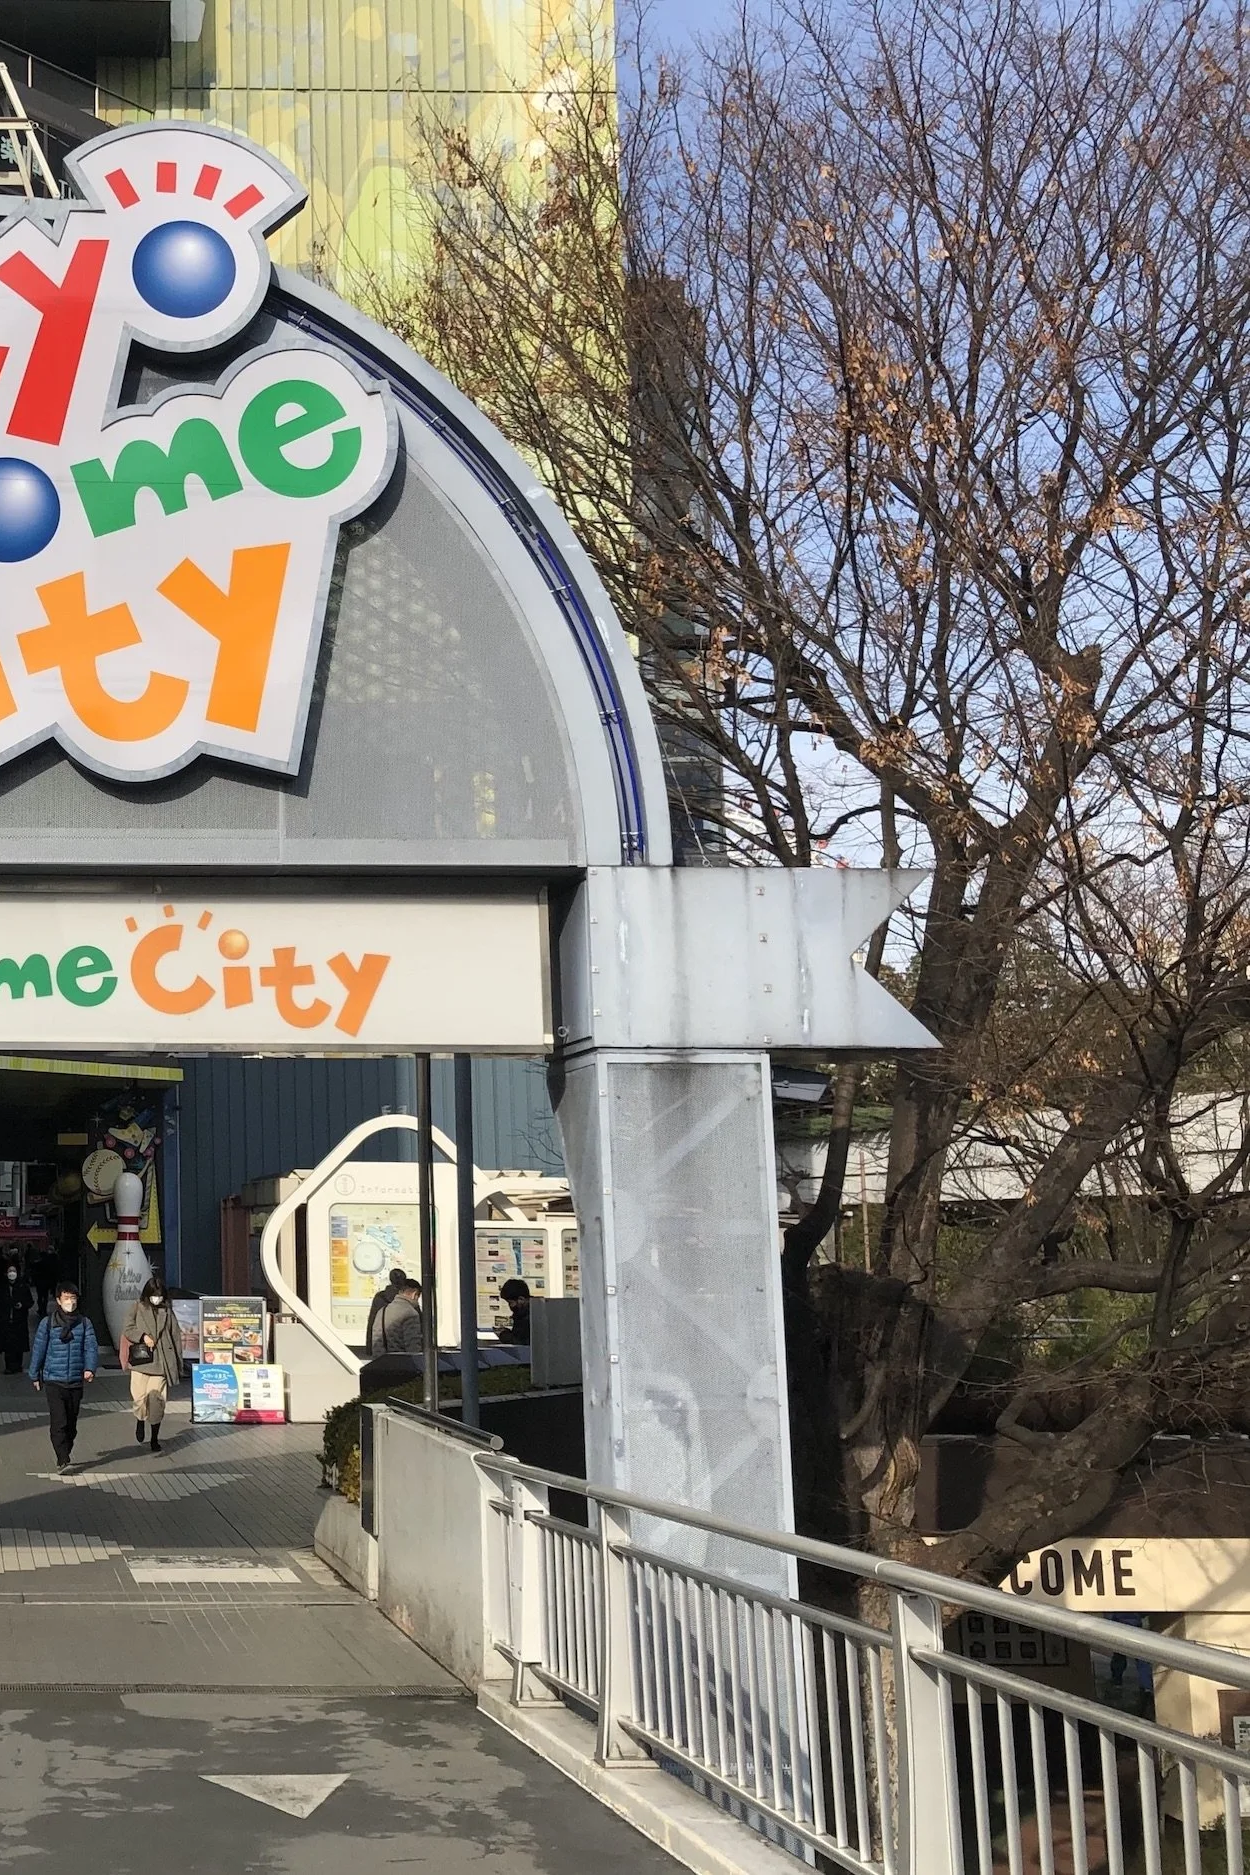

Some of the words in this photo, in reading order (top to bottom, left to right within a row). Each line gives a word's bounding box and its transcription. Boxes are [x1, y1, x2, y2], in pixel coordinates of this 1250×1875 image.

[129, 923, 392, 1037] City
[358, 1185, 420, 1194] Informati
[1009, 1549, 1136, 1597] COME
